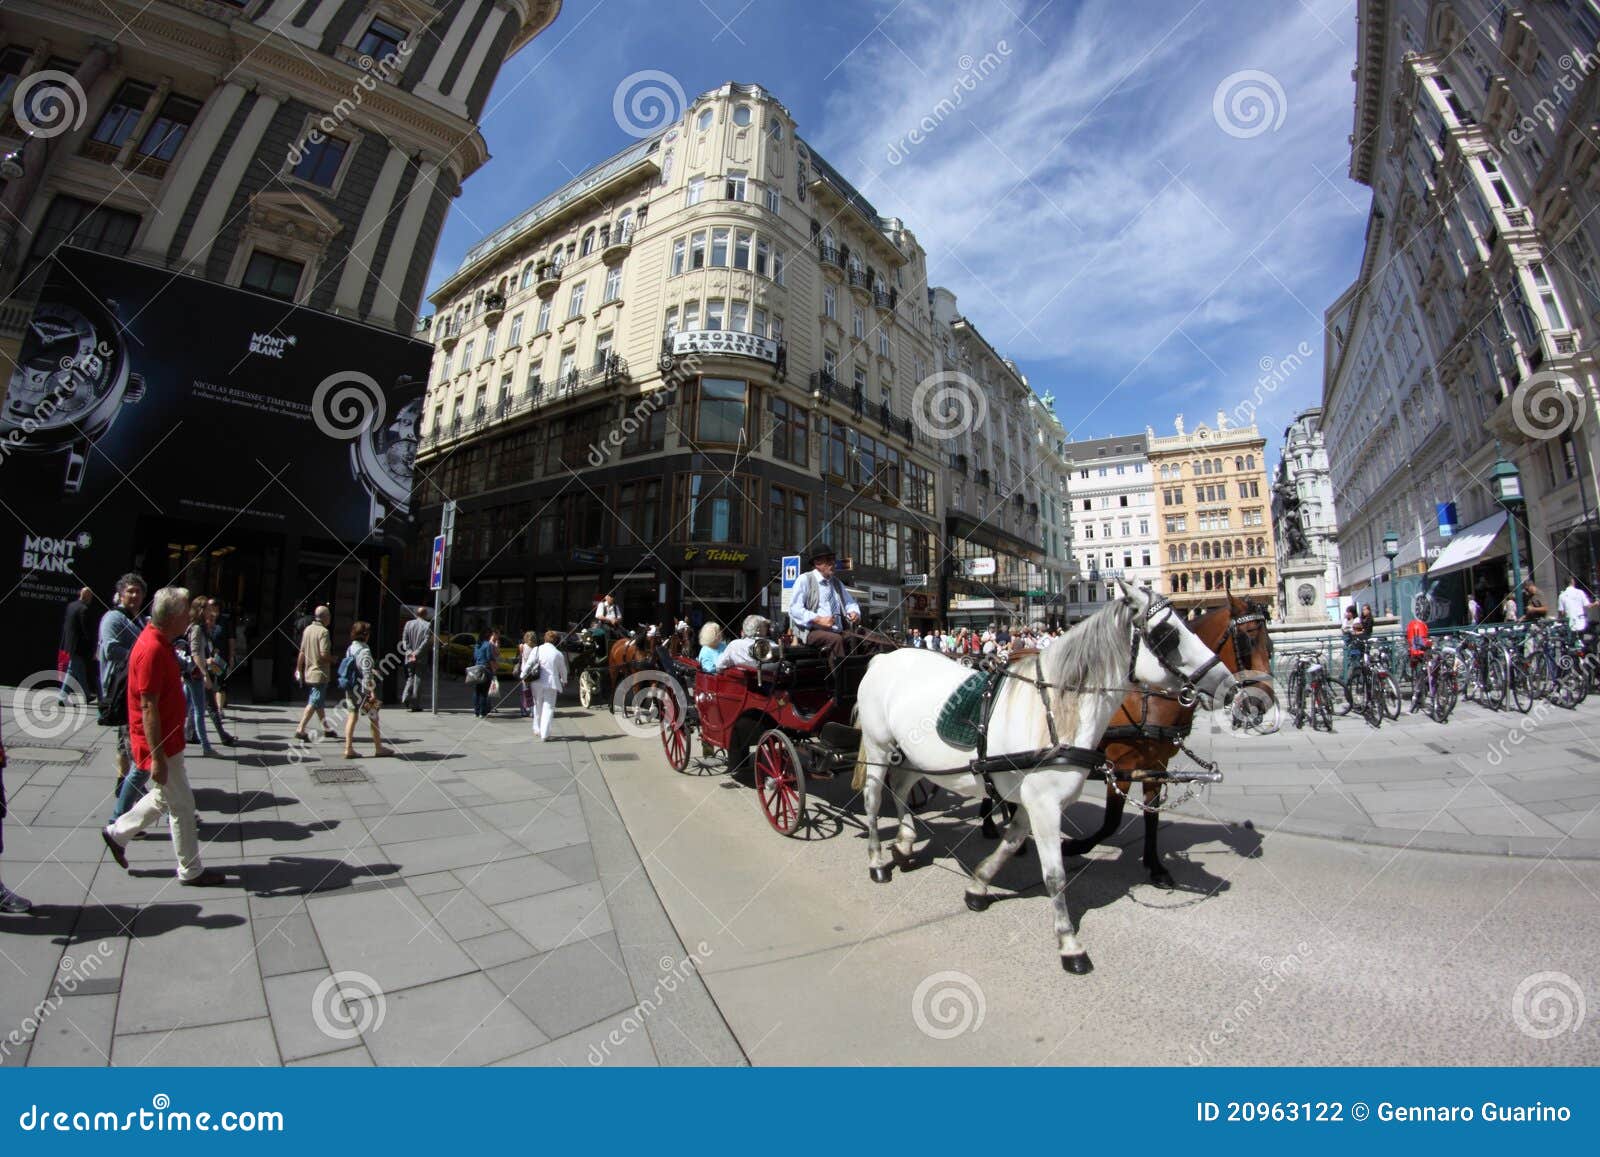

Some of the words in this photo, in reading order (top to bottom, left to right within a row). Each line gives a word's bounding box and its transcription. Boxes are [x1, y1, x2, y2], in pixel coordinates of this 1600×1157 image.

[252, 332, 287, 349] MONT
[249, 342, 284, 359] BLANC
[678, 341, 773, 359] KRAWATTEN
[192, 379, 227, 394] NICOLAS
[266, 396, 312, 412] TIMEWRITE
[24, 534, 77, 557] MONT
[706, 548, 750, 561] Tchibo
[22, 551, 76, 575] BLANC
